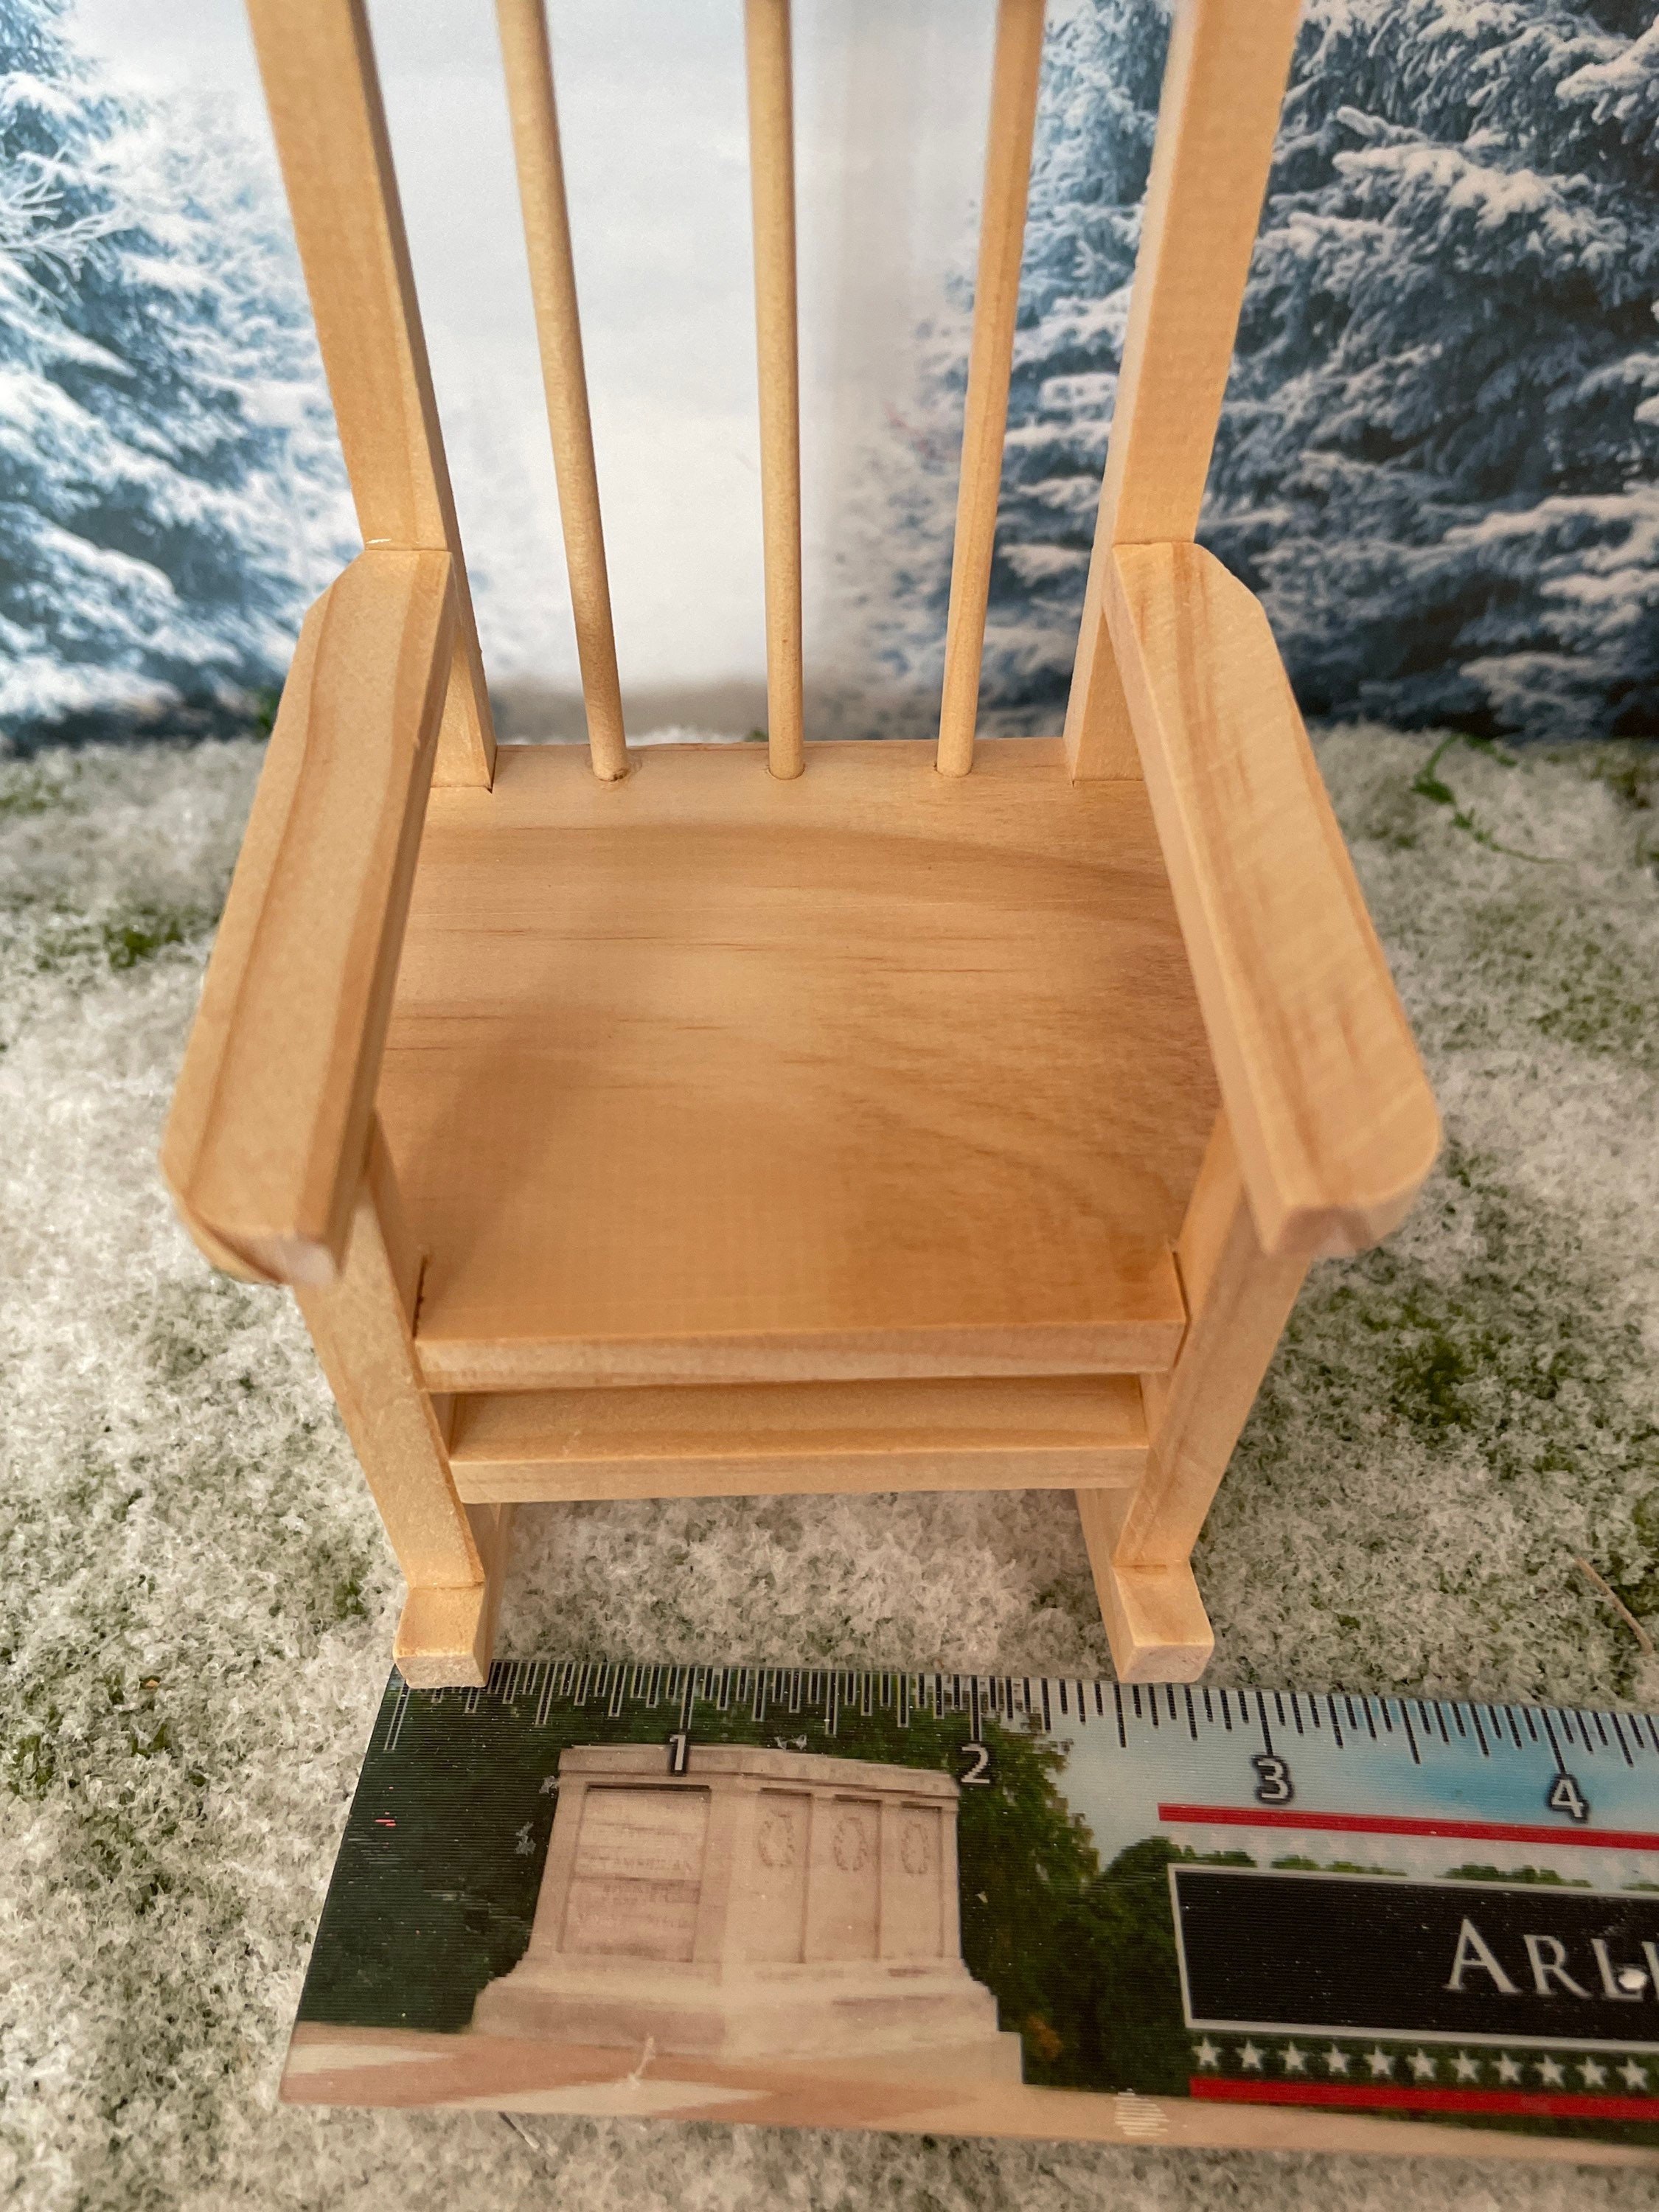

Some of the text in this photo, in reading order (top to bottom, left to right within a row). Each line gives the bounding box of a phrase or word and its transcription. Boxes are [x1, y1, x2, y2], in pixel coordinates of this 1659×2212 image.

[669, 1733, 1584, 1818] 1 2 3 4
